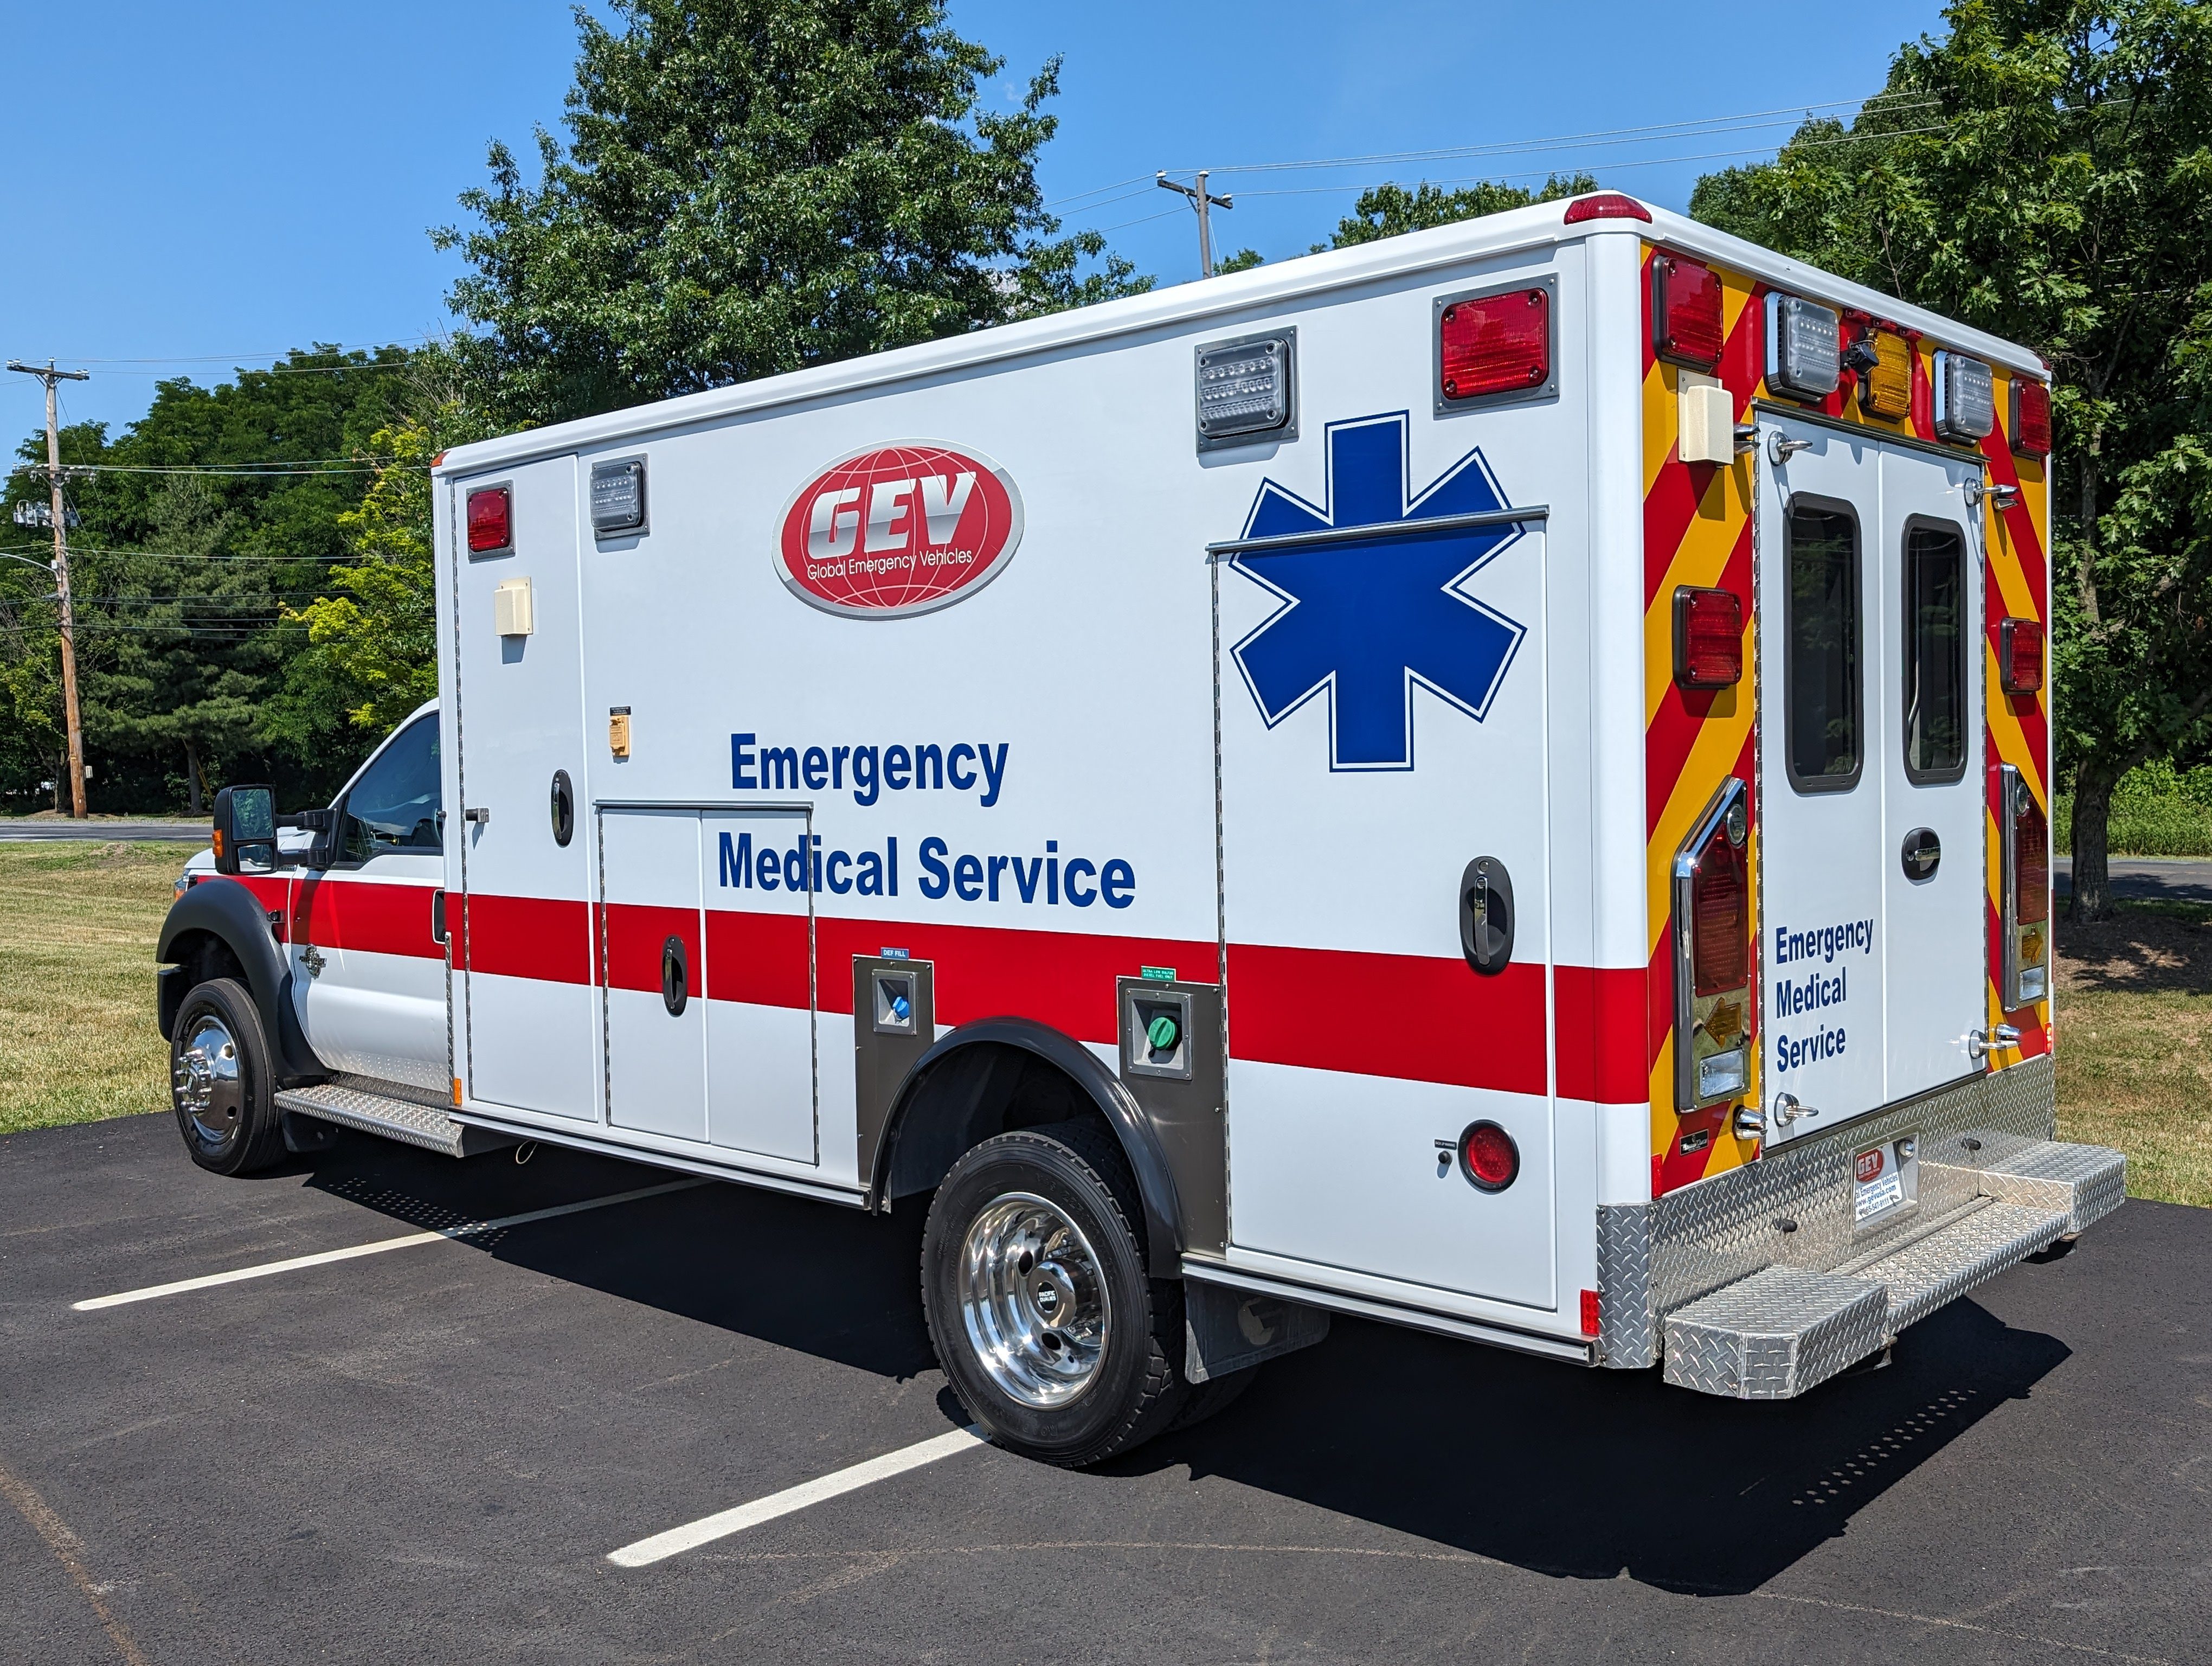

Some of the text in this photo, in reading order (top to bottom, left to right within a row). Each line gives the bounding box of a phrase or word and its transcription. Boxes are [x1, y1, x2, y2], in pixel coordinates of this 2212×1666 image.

[807, 471, 976, 559] GEV
[807, 547, 972, 580] Global Emergency Vehicles
[731, 733, 1009, 808] Emergency
[719, 832, 1136, 909] Medical Service
[1776, 919, 1874, 964] Emergency
[1776, 966, 1846, 1018] Medical
[1777, 1024, 1846, 1073] Service
[1857, 1152, 1879, 1175] GEV
